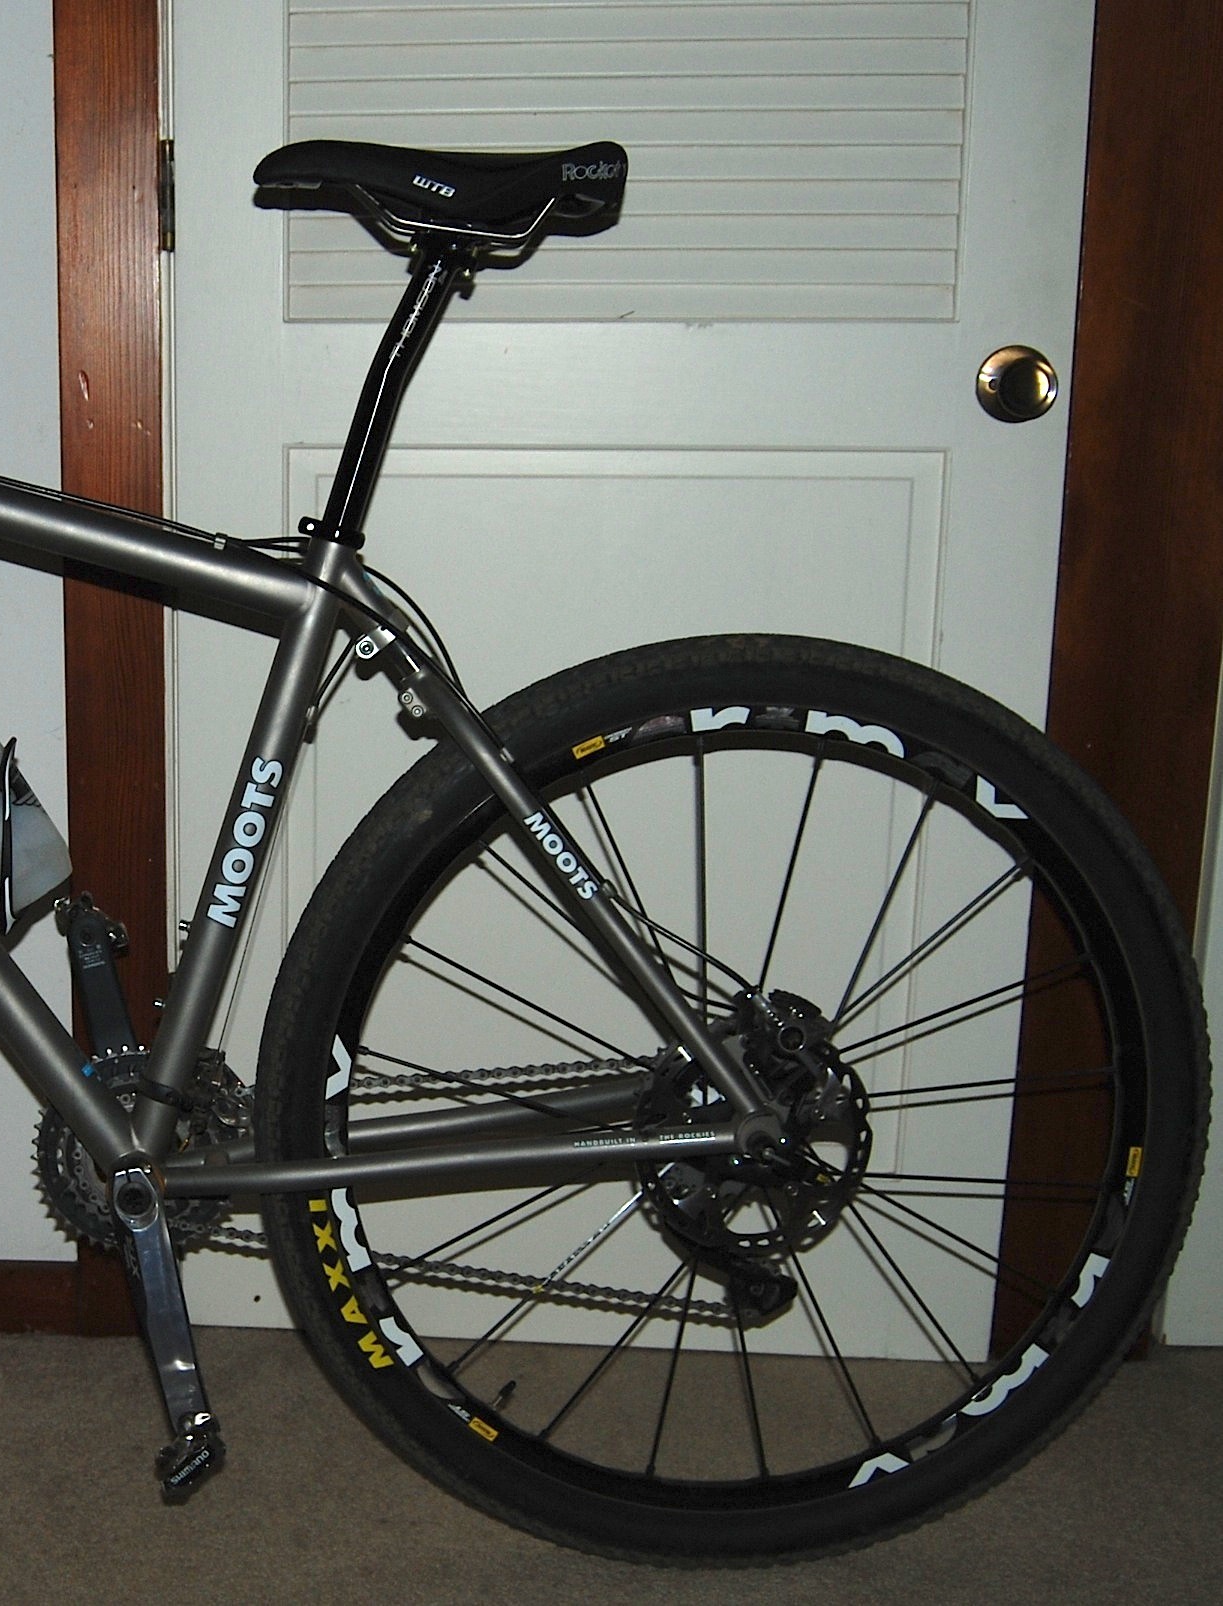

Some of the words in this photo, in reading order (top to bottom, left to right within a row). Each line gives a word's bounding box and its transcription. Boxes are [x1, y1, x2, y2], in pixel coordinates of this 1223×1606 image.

[412, 174, 457, 198] WTB
[207, 757, 284, 928] MOOTS
[524, 811, 600, 901] MOOTS
[309, 1200, 394, 1370] MAXXI
[169, 1448, 210, 1486] SHIMANO
